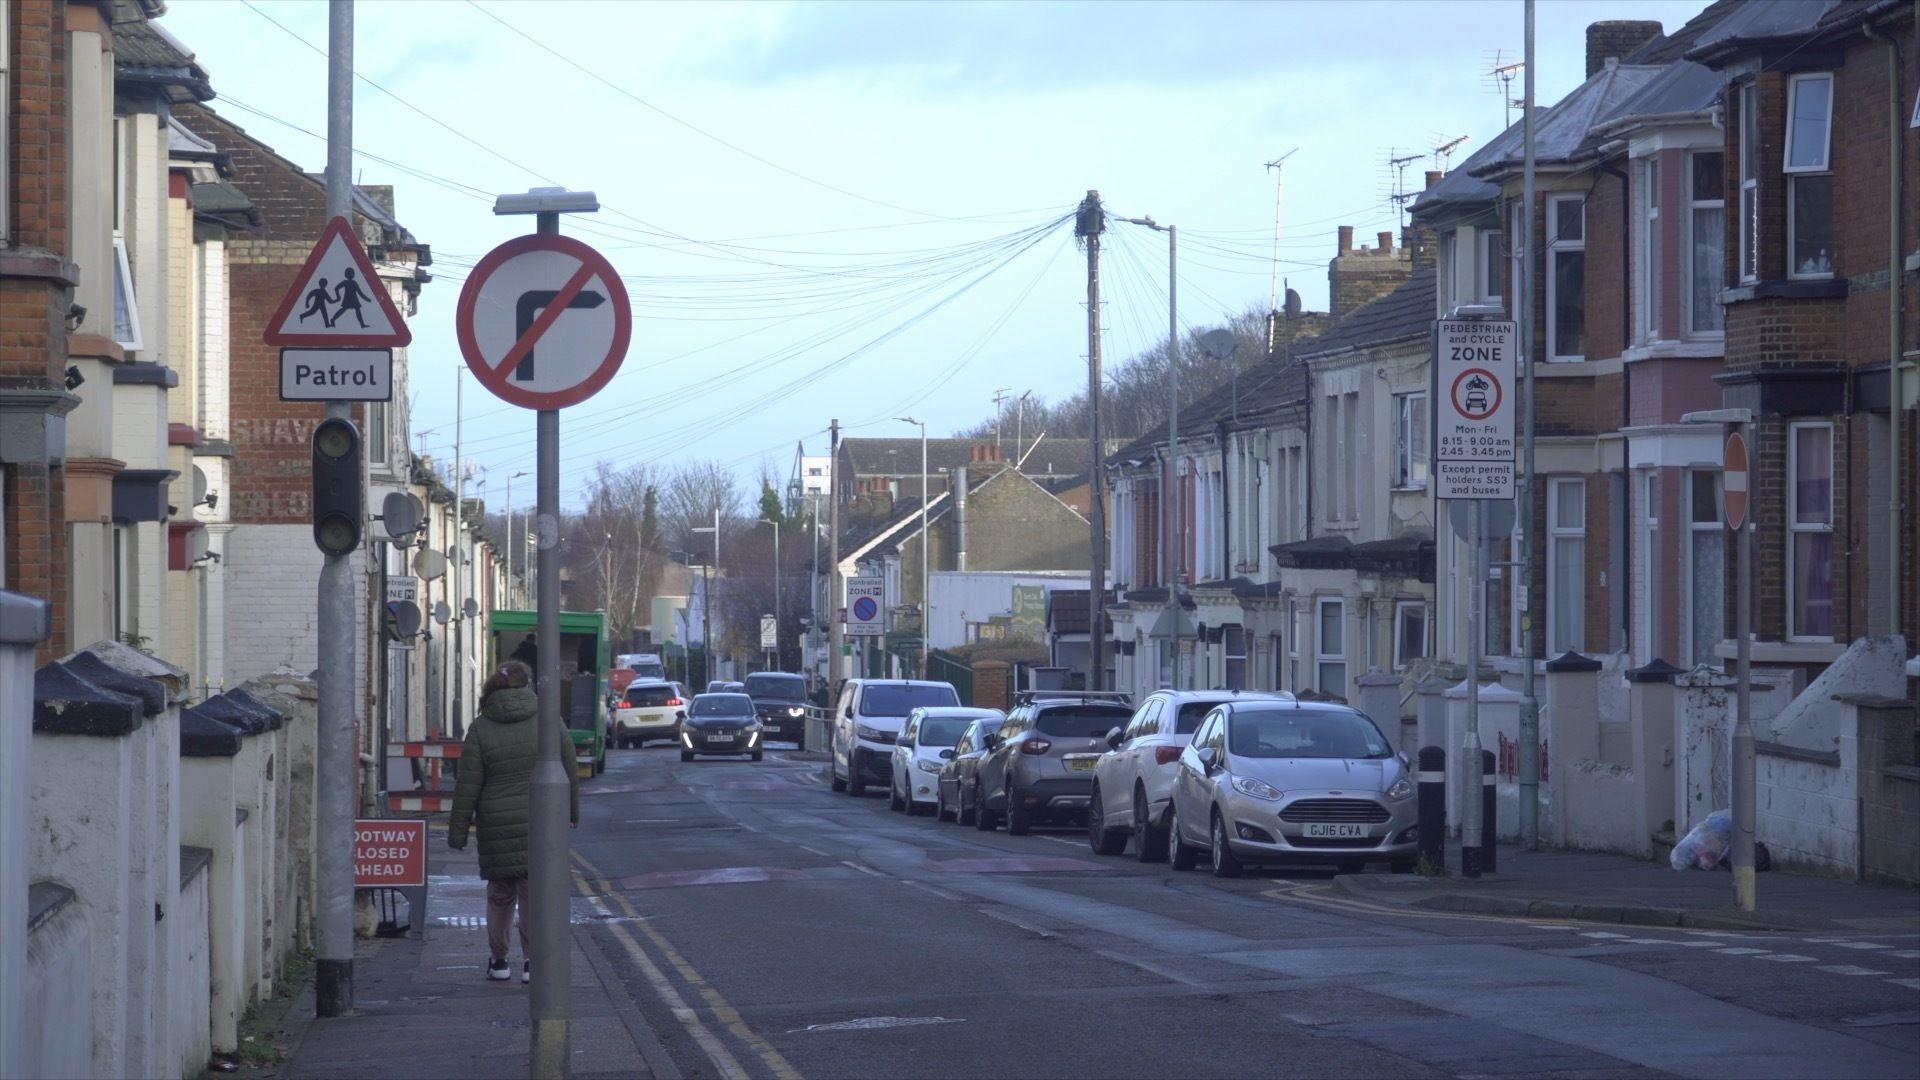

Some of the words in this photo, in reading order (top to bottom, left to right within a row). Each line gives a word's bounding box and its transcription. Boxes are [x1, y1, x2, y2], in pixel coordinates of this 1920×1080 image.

[1443, 324, 1511, 333] PEDESTRIAN
[1449, 335, 1467, 344] and
[1470, 335, 1505, 344] CYCLE
[1451, 347, 1502, 361] ZONE
[295, 364, 377, 386] Patrol
[231, 418, 313, 444] SHAV
[1455, 425, 1477, 434] Mon
[1484, 425, 1497, 434] Fri
[1496, 449, 1511, 457] pm
[1442, 464, 1476, 474] Except
[1478, 465, 1510, 474] permit
[1446, 475, 1482, 484] holders
[1486, 475, 1508, 485] SS3
[1451, 486, 1469, 494] and
[1472, 486, 1500, 494] buses
[1310, 824, 1336, 836] GJ16
[1339, 824, 1362, 836] CVA
[354, 830, 417, 842] OTWAY
[354, 847, 410, 859] LOSED
[353, 864, 405, 876] AHEAD
